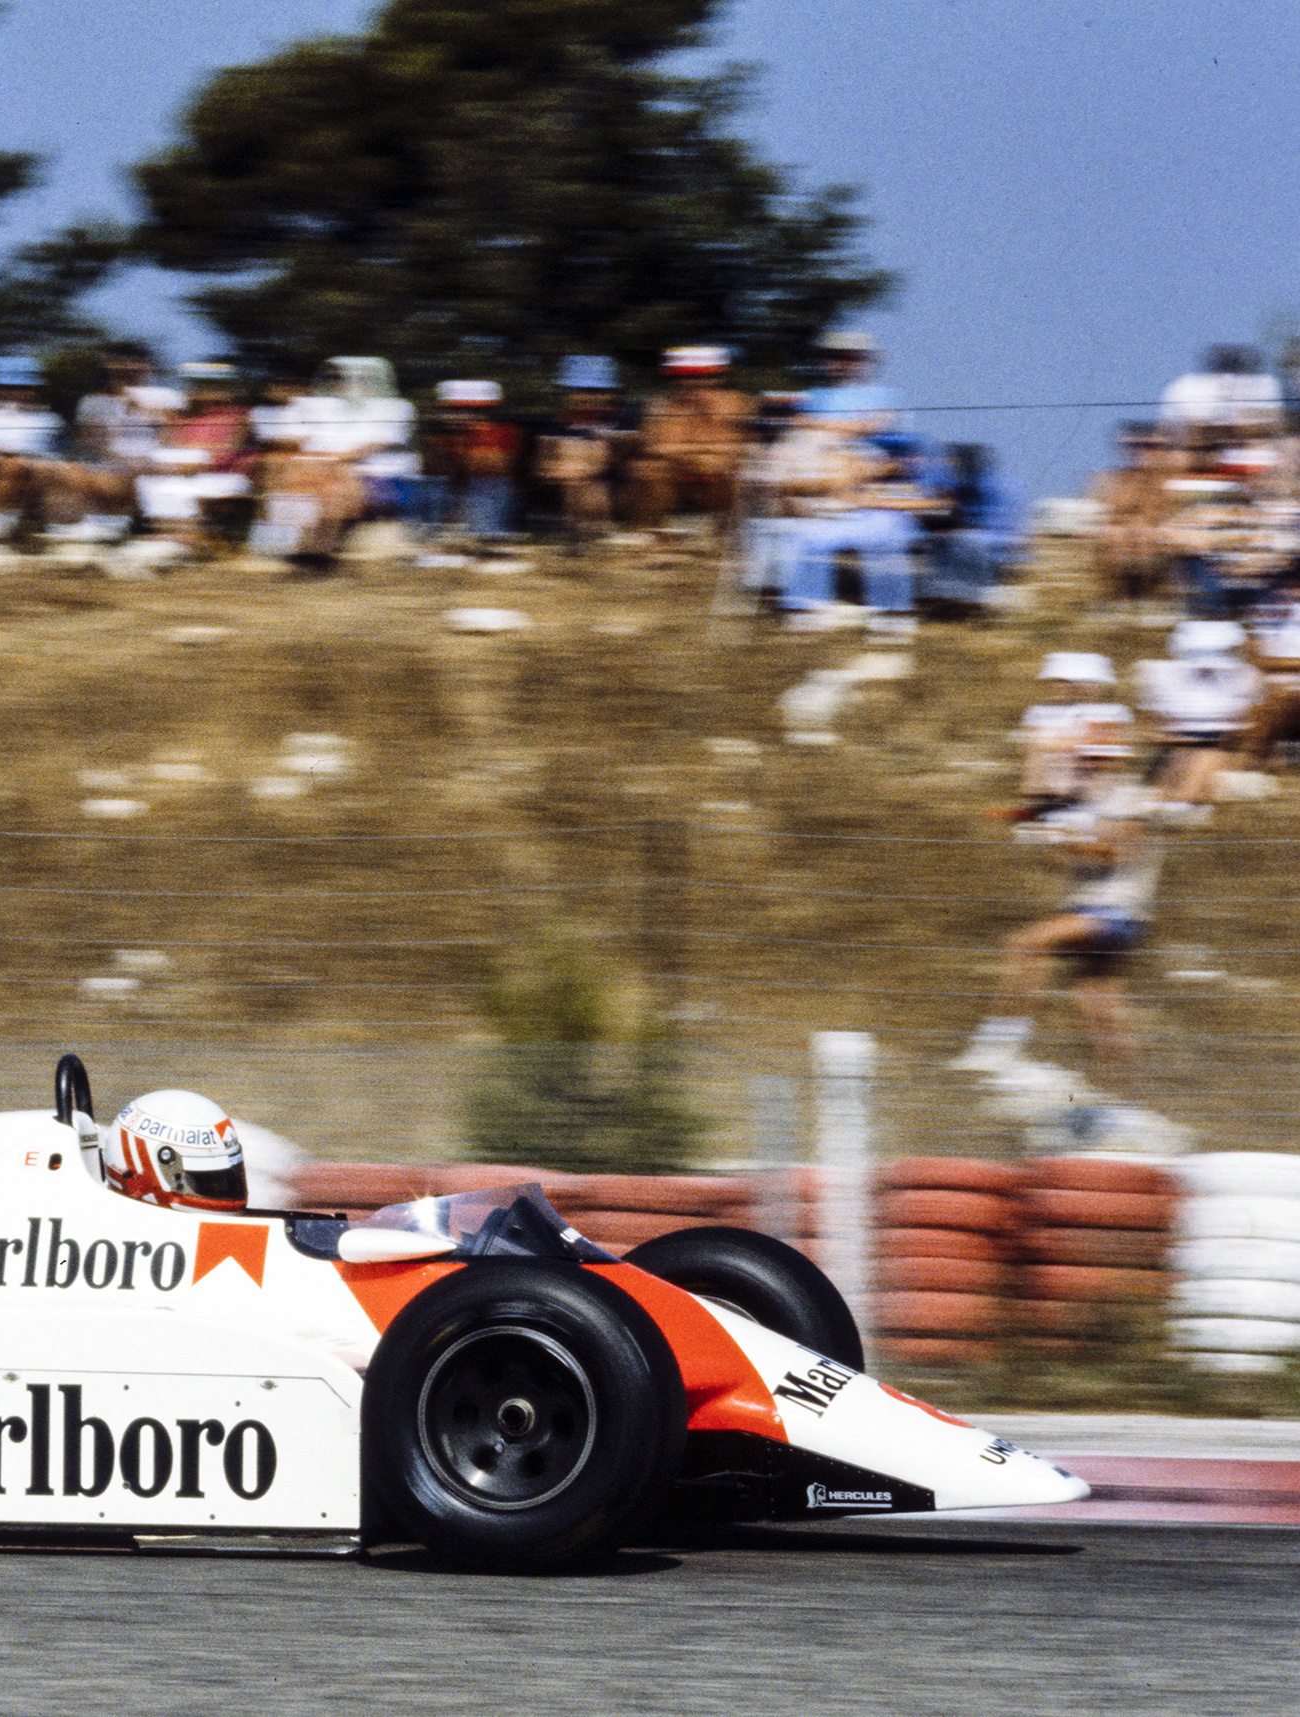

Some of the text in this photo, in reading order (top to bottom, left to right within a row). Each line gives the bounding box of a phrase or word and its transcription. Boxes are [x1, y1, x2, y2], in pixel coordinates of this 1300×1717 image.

[137, 1118, 217, 1146] parmalat
[24, 1151, 40, 1166] E
[828, 1491, 892, 1501] HERCULES
